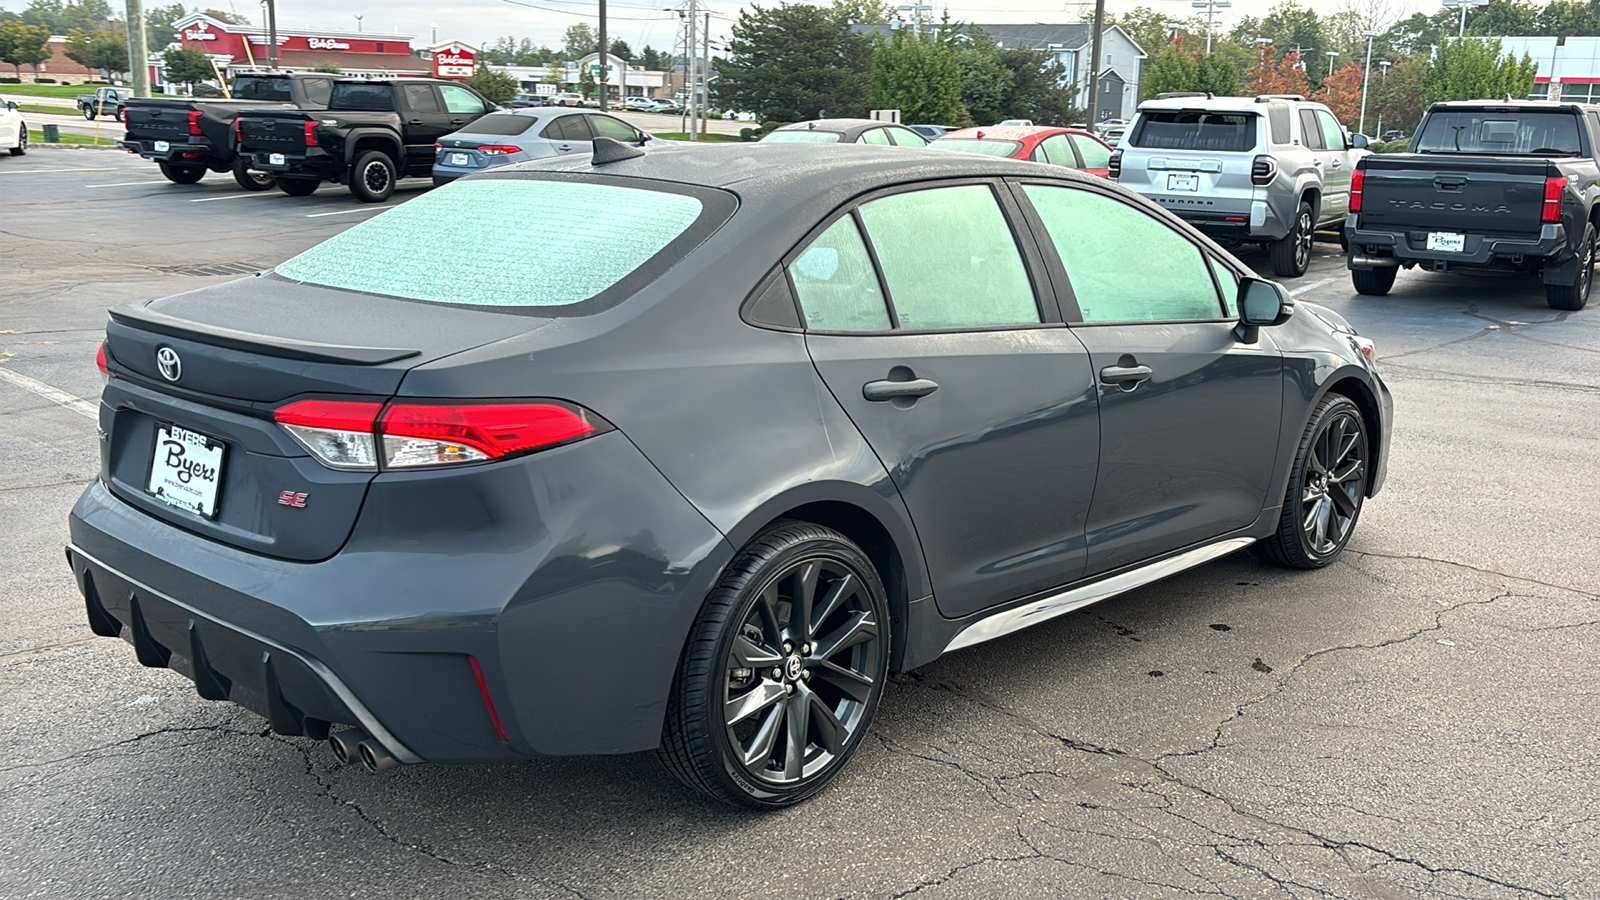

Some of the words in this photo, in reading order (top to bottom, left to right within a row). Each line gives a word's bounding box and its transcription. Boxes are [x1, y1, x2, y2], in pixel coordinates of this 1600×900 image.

[308, 38, 327, 49] Bob
[326, 39, 350, 50] Evans
[437, 53, 453, 65] Bob
[452, 54, 474, 65] Evans
[136, 123, 180, 131] TACOMA
[249, 134, 295, 142] TACOMA
[1389, 199, 1511, 214] TACOMA
[1431, 235, 1461, 247] Byers
[171, 426, 208, 446] BYERS
[163, 440, 215, 484] Byers
[277, 490, 309, 508] SE
